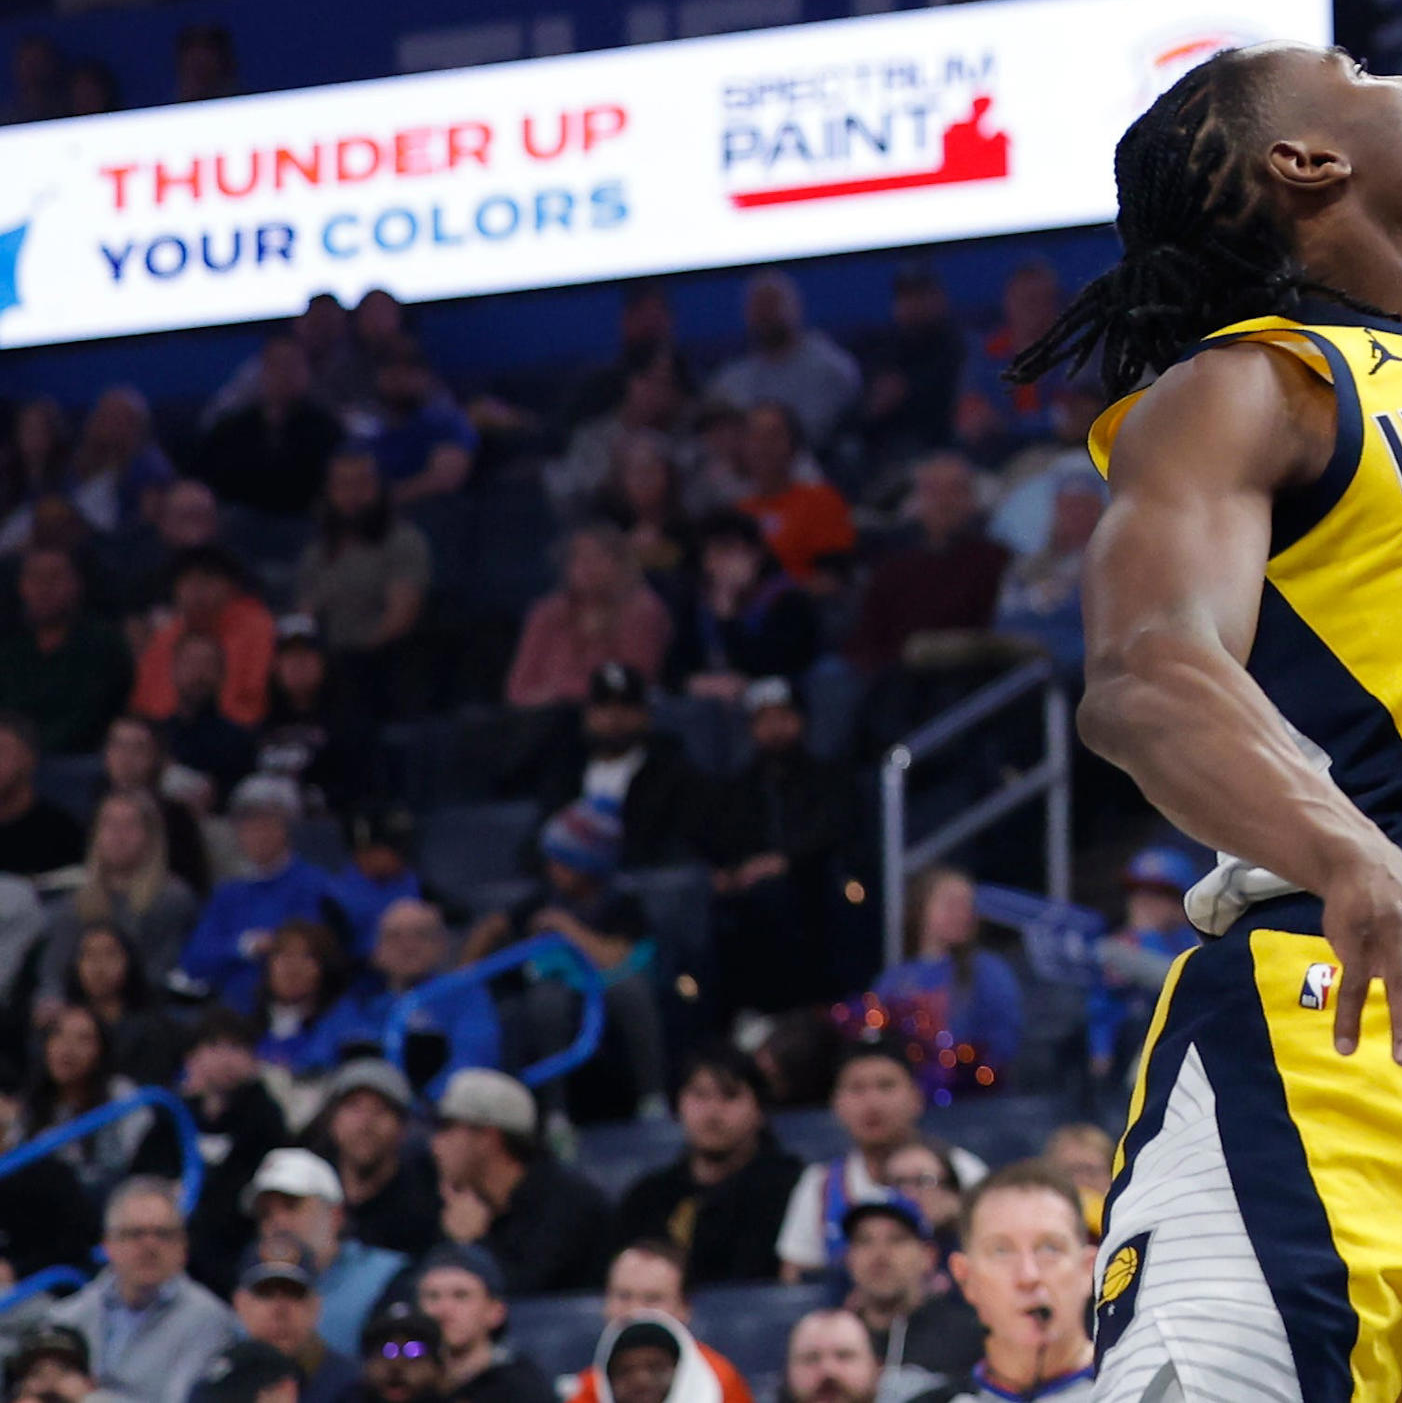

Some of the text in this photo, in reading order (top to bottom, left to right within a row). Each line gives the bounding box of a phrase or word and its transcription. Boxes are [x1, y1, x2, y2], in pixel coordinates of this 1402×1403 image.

[719, 48, 1000, 110] SPECTRUM
[100, 102, 630, 212] THUNDER UP
[719, 100, 940, 172] PAINT
[100, 179, 633, 285] YOUR COLORS
